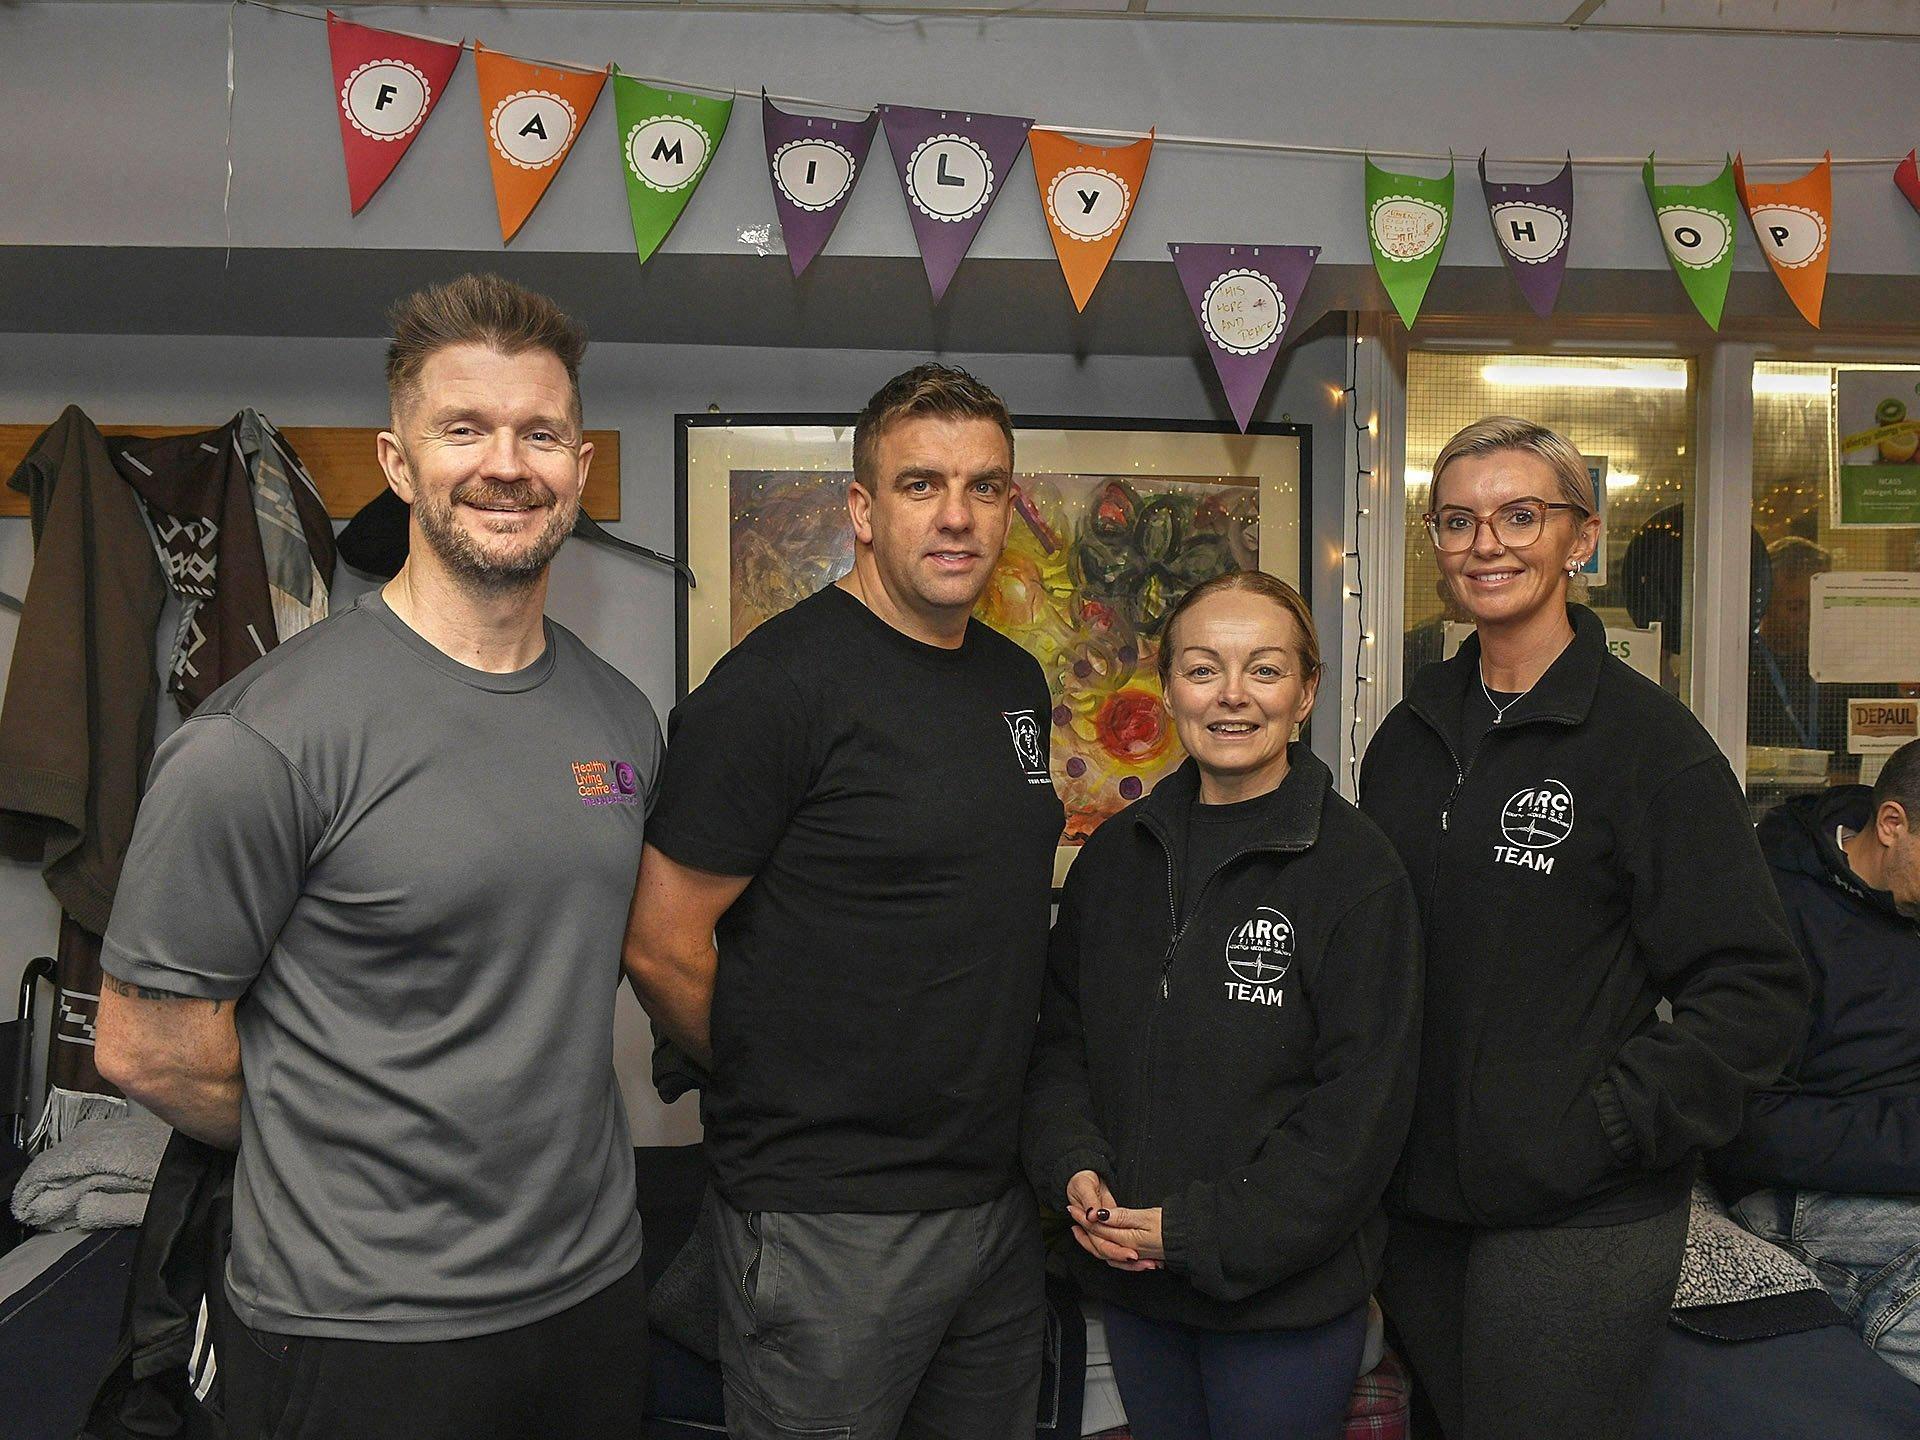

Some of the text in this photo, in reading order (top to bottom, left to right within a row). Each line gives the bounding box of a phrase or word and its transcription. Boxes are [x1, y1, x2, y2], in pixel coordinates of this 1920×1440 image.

[1609, 641, 1631, 659] ES
[1856, 707, 1915, 726] DEPAUL
[571, 761, 607, 775] Healthy
[575, 773, 603, 786] Living
[578, 784, 610, 797] Centre
[1516, 790, 1569, 812] ARC
[1493, 845, 1555, 875] TEAM
[1238, 919, 1290, 941] ARC
[1239, 938, 1286, 950] FITNESS
[1224, 982, 1284, 1007] TEAM
